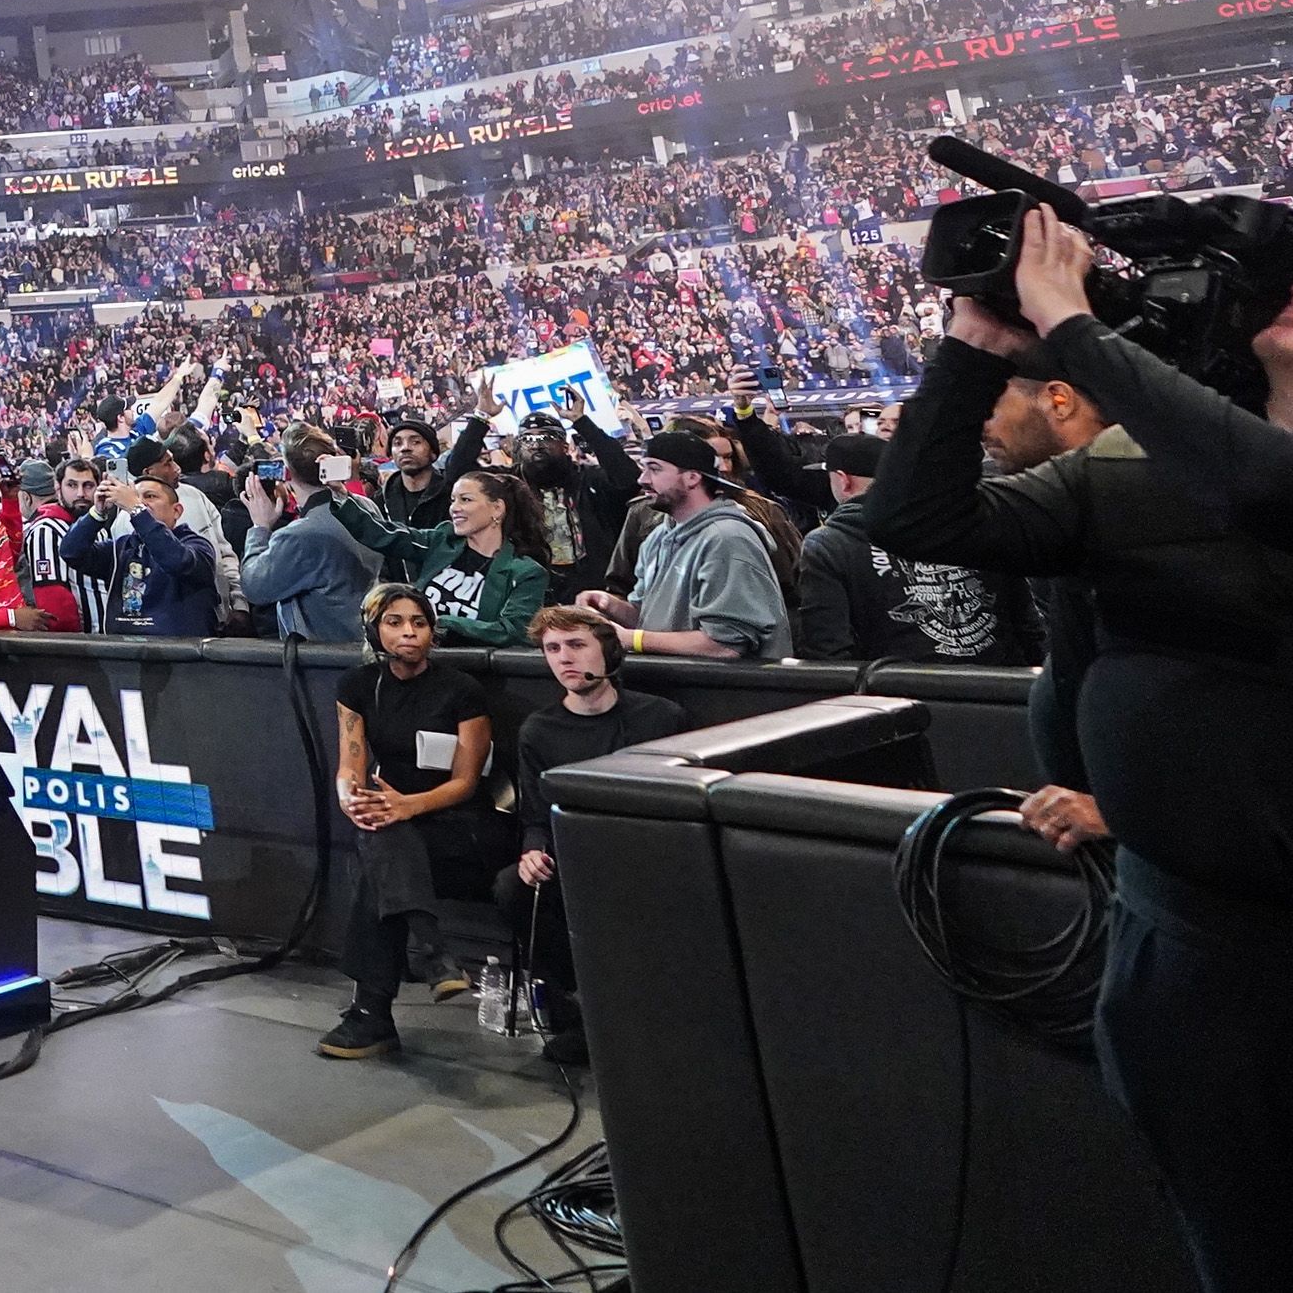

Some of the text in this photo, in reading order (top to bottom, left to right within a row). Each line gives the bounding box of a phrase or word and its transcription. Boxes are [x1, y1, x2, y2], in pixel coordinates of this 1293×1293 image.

[383, 131, 465, 161] ROYAL
[4, 173, 81, 195] ROYAL
[852, 228, 879, 243] 125
[34, 809, 211, 920] BLE
